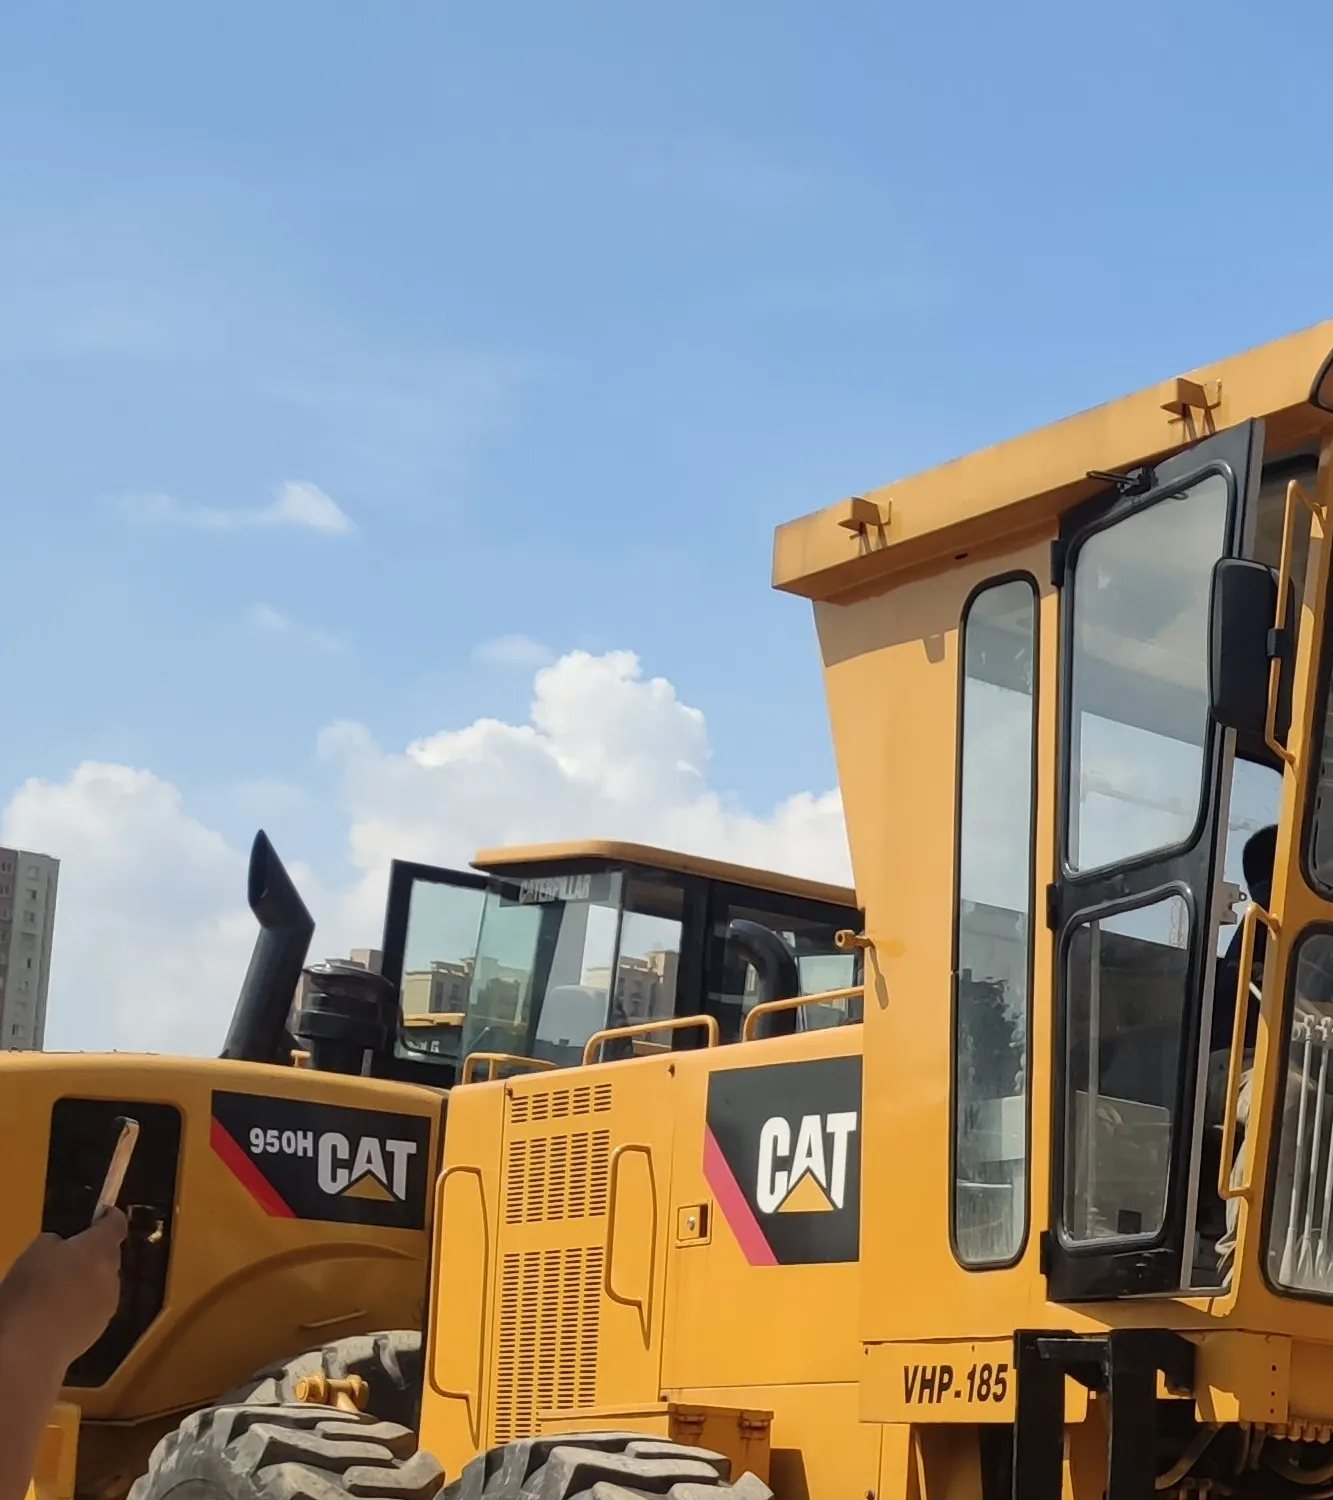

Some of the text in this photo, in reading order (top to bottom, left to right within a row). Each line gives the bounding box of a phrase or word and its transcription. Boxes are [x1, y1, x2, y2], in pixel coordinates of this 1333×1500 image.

[250, 1127, 417, 1201] 950H CAT
[756, 1111, 858, 1214] CAT
